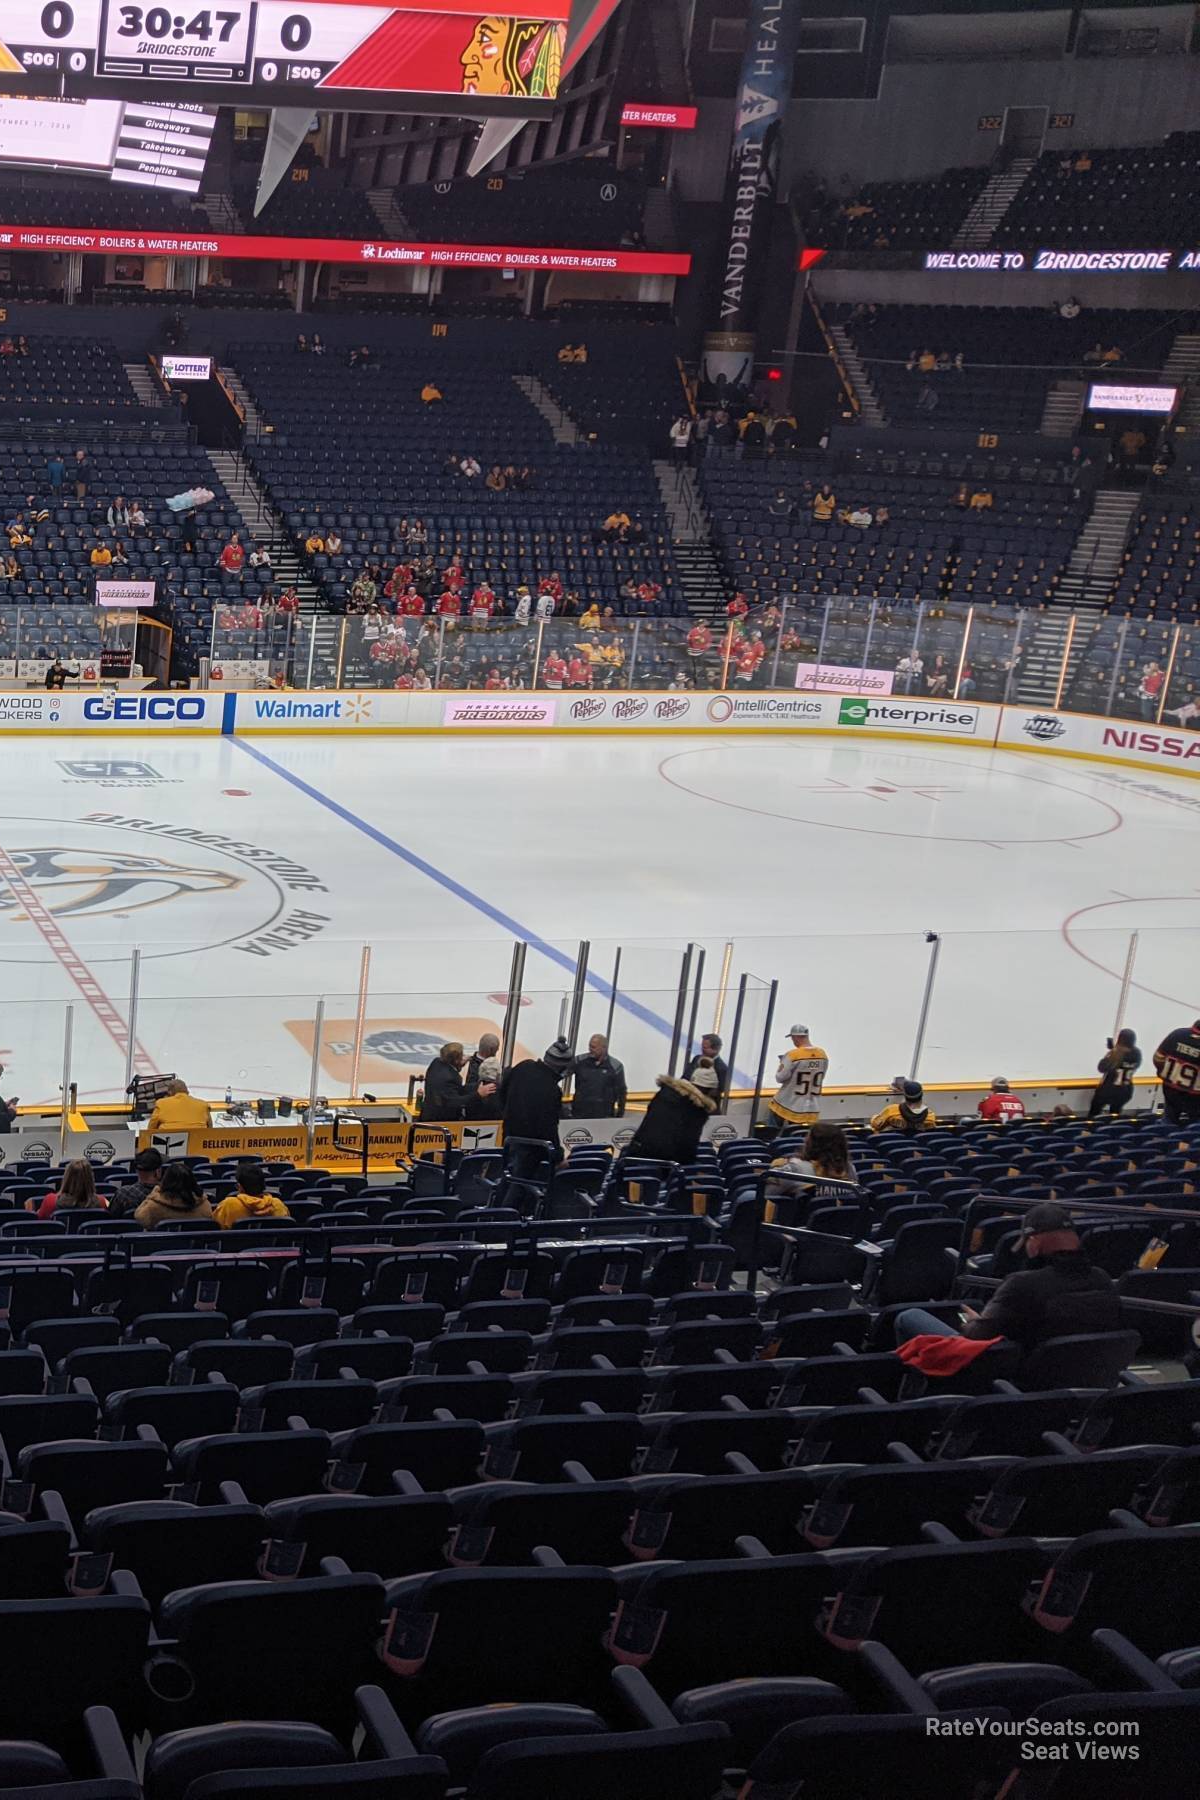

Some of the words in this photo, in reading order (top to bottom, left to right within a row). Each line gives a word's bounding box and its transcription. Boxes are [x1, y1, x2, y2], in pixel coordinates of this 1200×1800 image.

[40, 0, 74, 39] 0
[117, 5, 241, 42] 30:47
[280, 14, 312, 51] 0
[136, 41, 217, 58] BRIDGESTONE
[22, 52, 55, 66] SOG
[70, 52, 86, 72] 0
[261, 62, 278, 82] 0
[291, 66, 322, 81] SOG
[641, 112, 677, 123] HEATERS
[145, 119, 191, 134] Giveaways
[140, 141, 187, 155] Takeaways
[138, 163, 178, 176] Penalties
[721, 139, 763, 318] VANDERBILT
[20, 233, 44, 244] HIGH
[46, 235, 96, 247] EFFICIENCY
[100, 237, 136, 248] BOILERS
[138, 238, 145, 248] &
[147, 239, 179, 250] WATER
[180, 241, 218, 252] HEATERS
[377, 247, 425, 260] Lochinvar
[431, 251, 453, 261] HIGH
[455, 252, 502, 263] EFFICIENCY
[506, 254, 540, 265] BOILERS
[541, 255, 548, 264] &
[550, 256, 579, 266] WATER
[581, 257, 617, 268] HEATERS
[926, 254, 1001, 268] WELCOME
[1003, 254, 1024, 268] TO
[1033, 252, 1172, 270] BRIDGESTONE
[174, 364, 208, 373] LOTTERY
[977, 434, 999, 448] 113
[84, 697, 206, 721] GEICO
[256, 699, 341, 719] Walmart
[573, 704, 604, 719] Pepper
[583, 698, 597, 708] Dr
[614, 704, 646, 719] Pepper
[625, 698, 639, 708] Dr
[656, 704, 688, 719] Pepper
[667, 698, 680, 708] Dr
[734, 700, 822, 713] IntelliCentrics
[453, 710, 548, 720] PREDATORS
[850, 704, 974, 730] enterprise
[1023, 718, 1066, 735] NHL
[78, 812, 330, 894] BRIDGESTONE
[232, 908, 332, 957] ARENA
[794, 1071, 825, 1096] 59
[202, 1139, 241, 1149] BELLEVUE
[247, 1138, 298, 1148] BRENTWOOD
[315, 1136, 330, 1145] MT.
[333, 1136, 357, 1146] ULIET
[367, 1135, 402, 1145] RANKLIN
[413, 1134, 458, 1144] OWNTON
